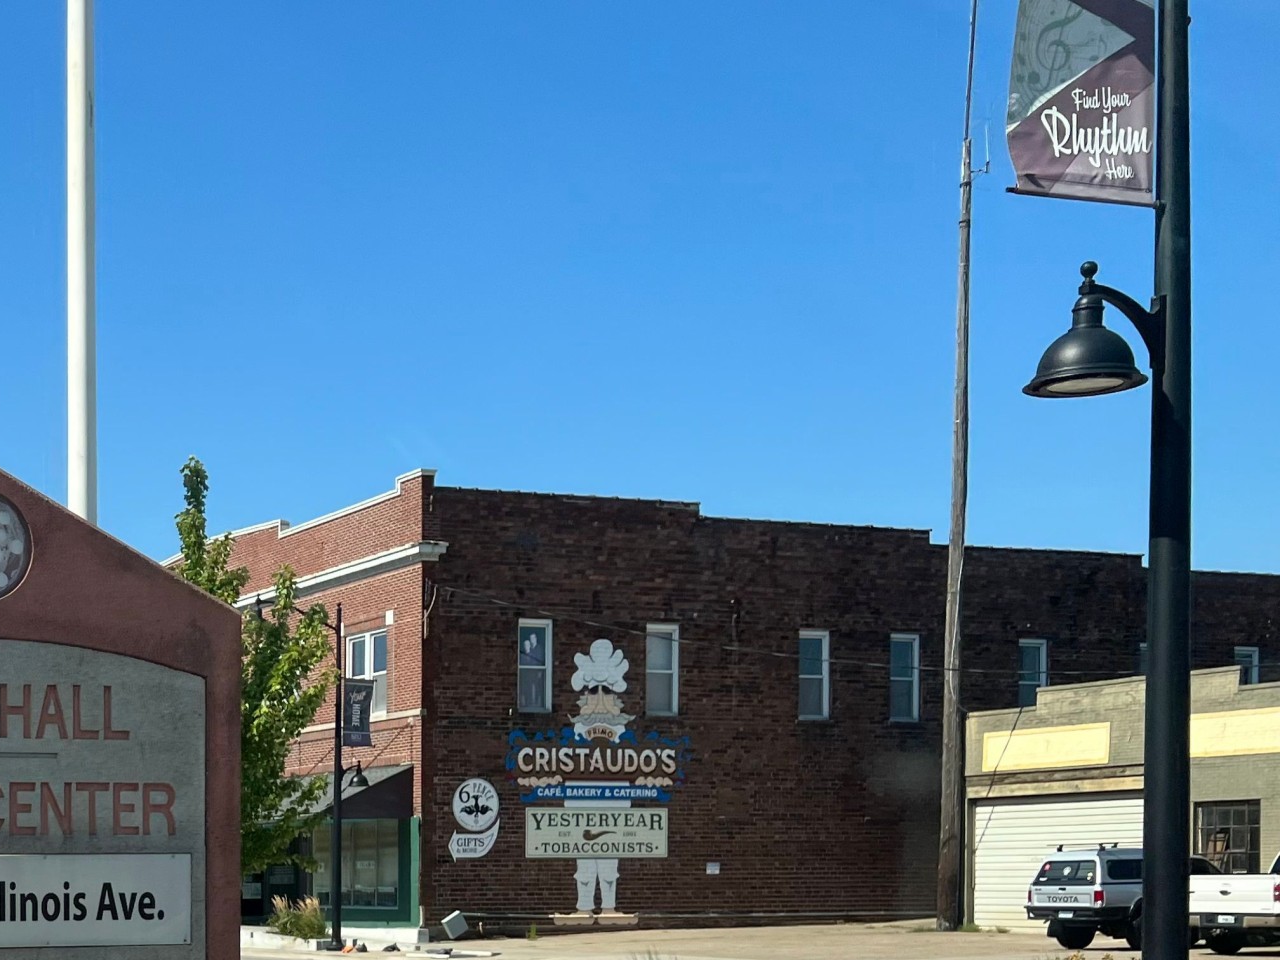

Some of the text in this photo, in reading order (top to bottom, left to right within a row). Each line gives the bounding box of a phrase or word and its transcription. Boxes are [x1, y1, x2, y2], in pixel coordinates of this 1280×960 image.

[1072, 87, 1131, 113] Find Your
[1041, 106, 1152, 167] Rhythm
[1105, 158, 1134, 180] Here
[0, 683, 130, 740] HALL
[352, 703, 360, 727] HOME
[587, 728, 614, 739] PRIMO
[517, 746, 676, 773] CRISTAUDO'S
[459, 782, 495, 803] 6 PENCE
[537, 786, 657, 797] CAFÉ, BAKERY & CATERING
[531, 813, 663, 831] YESTERYEAR
[456, 837, 485, 848] GIFTS
[541, 842, 654, 853] TOBACCONISTS
[96, 882, 165, 921] Ave.
